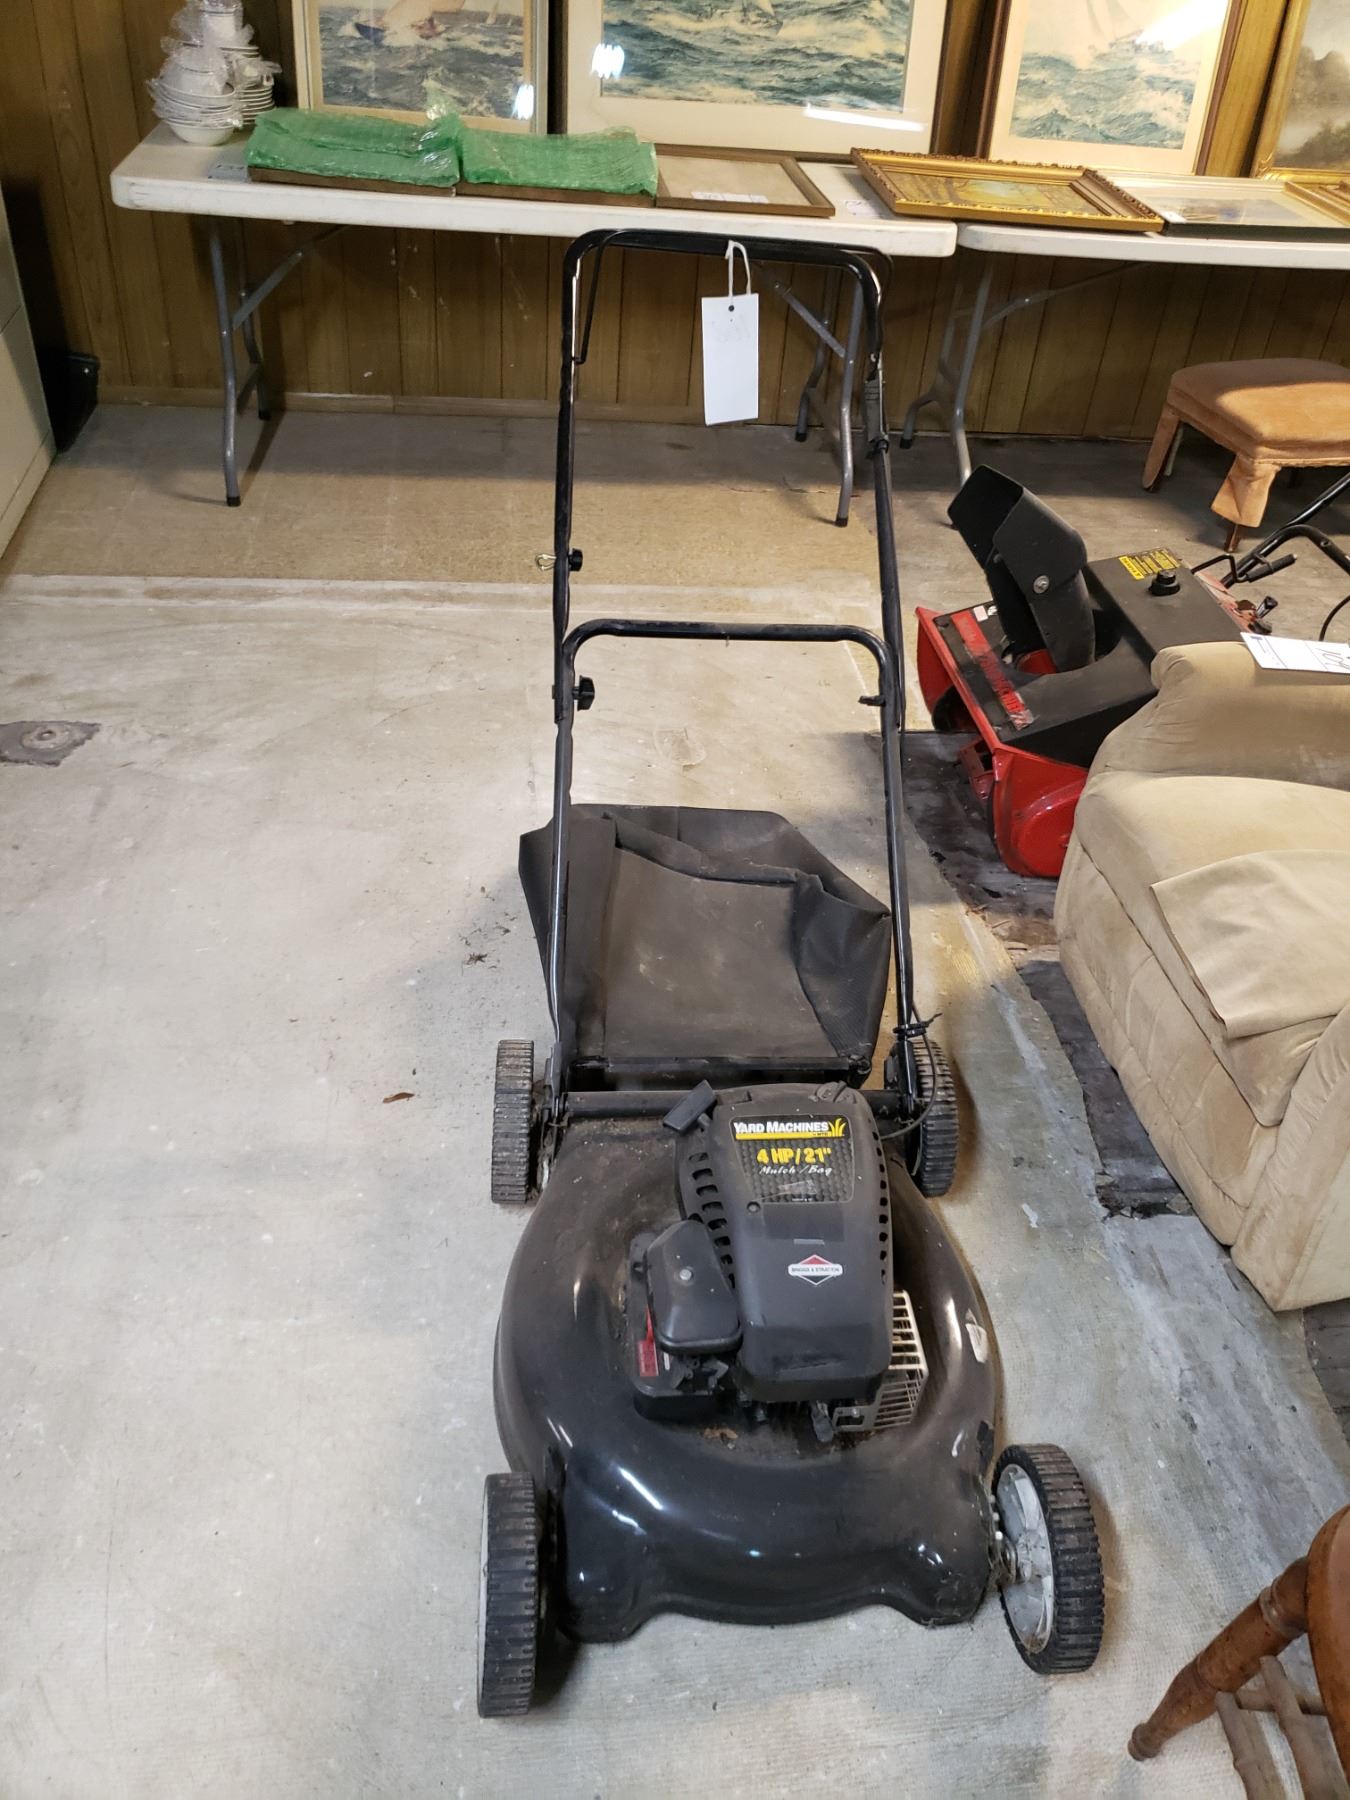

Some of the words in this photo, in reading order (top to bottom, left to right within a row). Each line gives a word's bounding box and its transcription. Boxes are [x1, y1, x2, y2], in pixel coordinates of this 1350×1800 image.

[734, 1121, 765, 1134] YARD
[766, 1121, 829, 1133] MACHINES
[757, 1148, 769, 1164] 4
